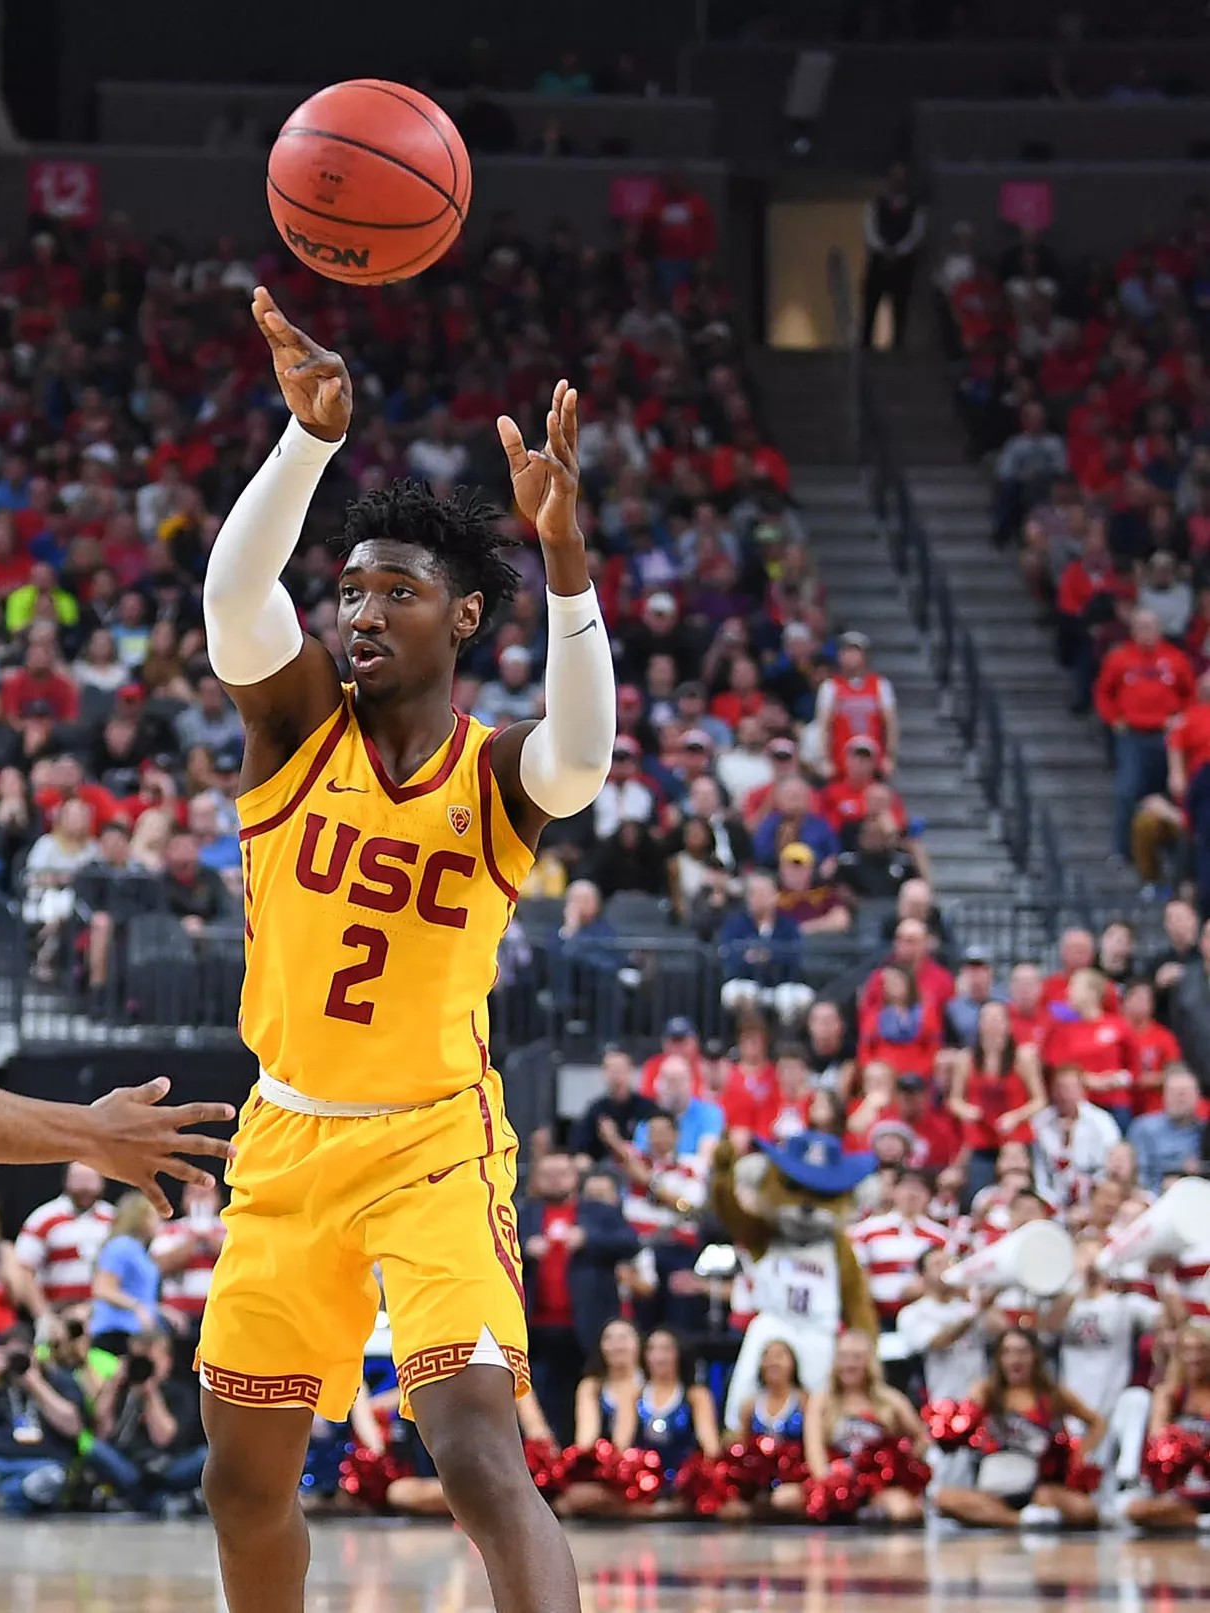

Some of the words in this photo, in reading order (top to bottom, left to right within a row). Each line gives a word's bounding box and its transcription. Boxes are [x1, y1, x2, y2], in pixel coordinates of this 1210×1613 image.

[285, 224, 369, 268] NCAA
[295, 812, 477, 930] USC
[323, 923, 390, 1025] 2
